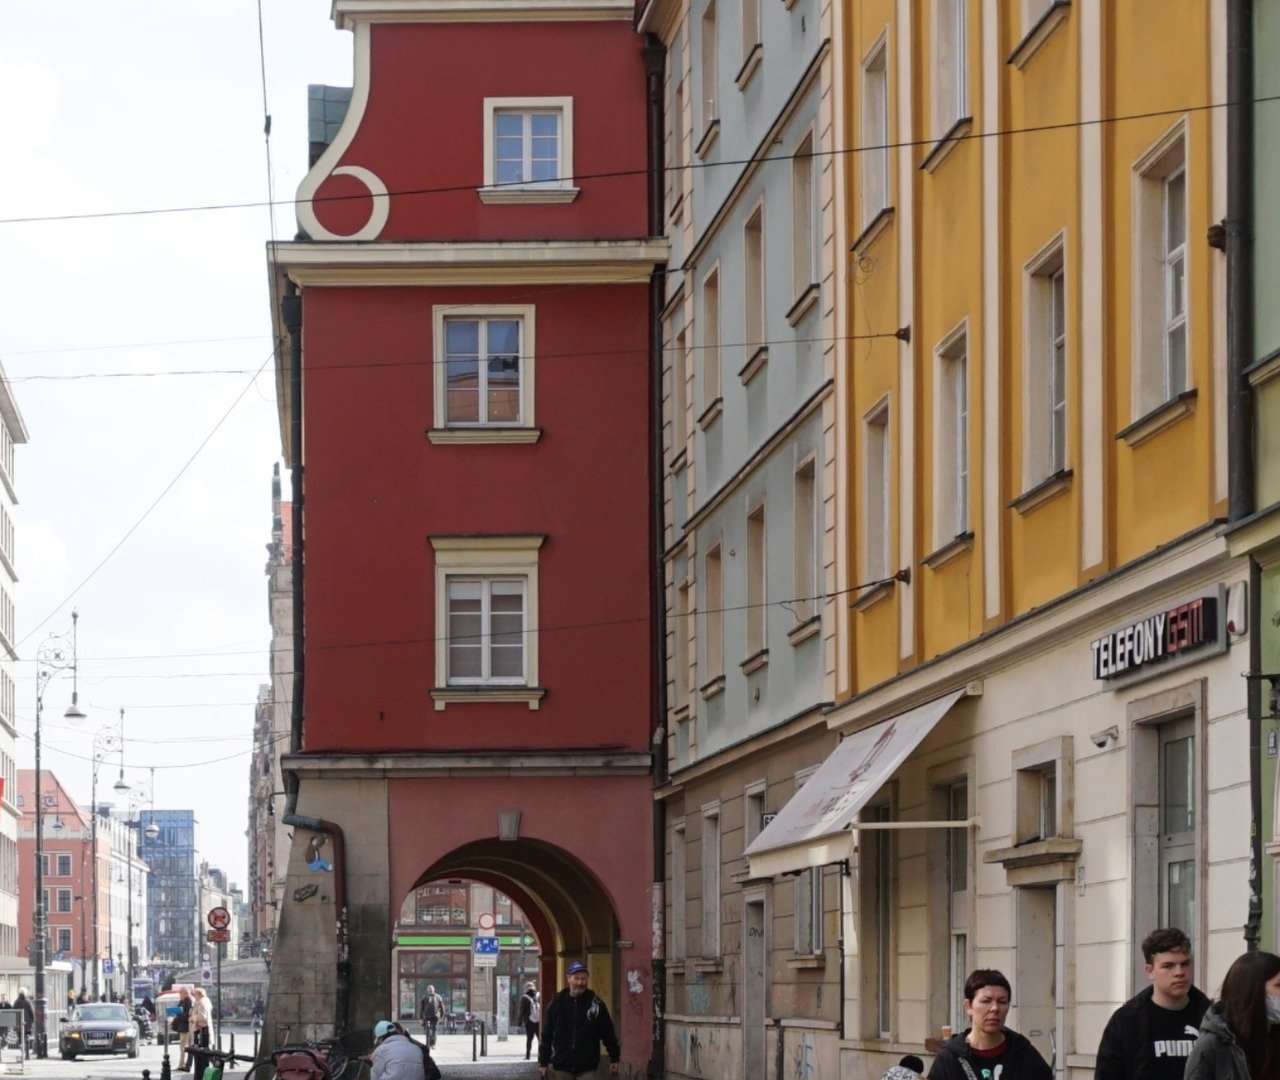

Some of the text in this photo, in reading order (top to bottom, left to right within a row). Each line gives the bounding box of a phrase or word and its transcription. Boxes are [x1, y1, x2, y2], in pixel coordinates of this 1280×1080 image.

[1091, 598, 1203, 680] TELEFONY GSM
[1154, 1040, 1199, 1058] PUM
